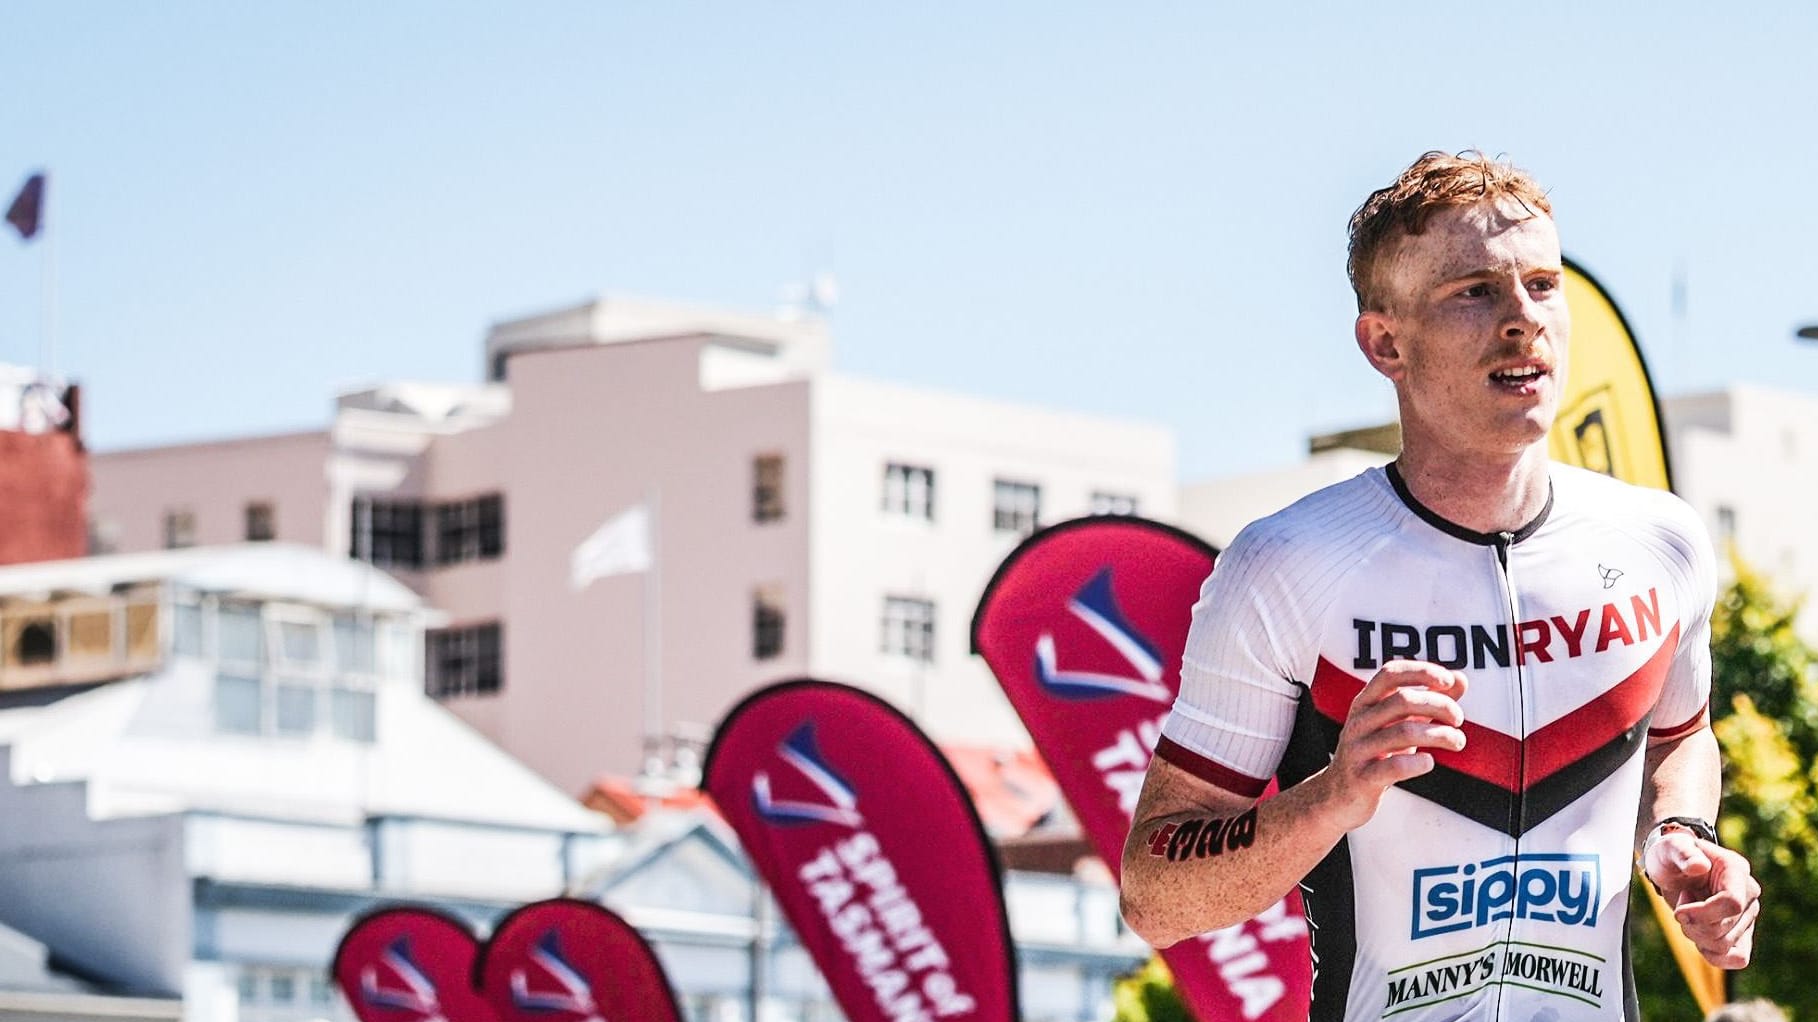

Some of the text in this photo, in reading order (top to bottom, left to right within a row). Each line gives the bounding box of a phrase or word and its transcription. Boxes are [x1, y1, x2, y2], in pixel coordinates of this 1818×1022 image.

[836, 830, 976, 1016] SPIRIT of
[1426, 863, 1591, 928] sippy
[1385, 951, 1604, 1009] MANNY'S MORWELL
